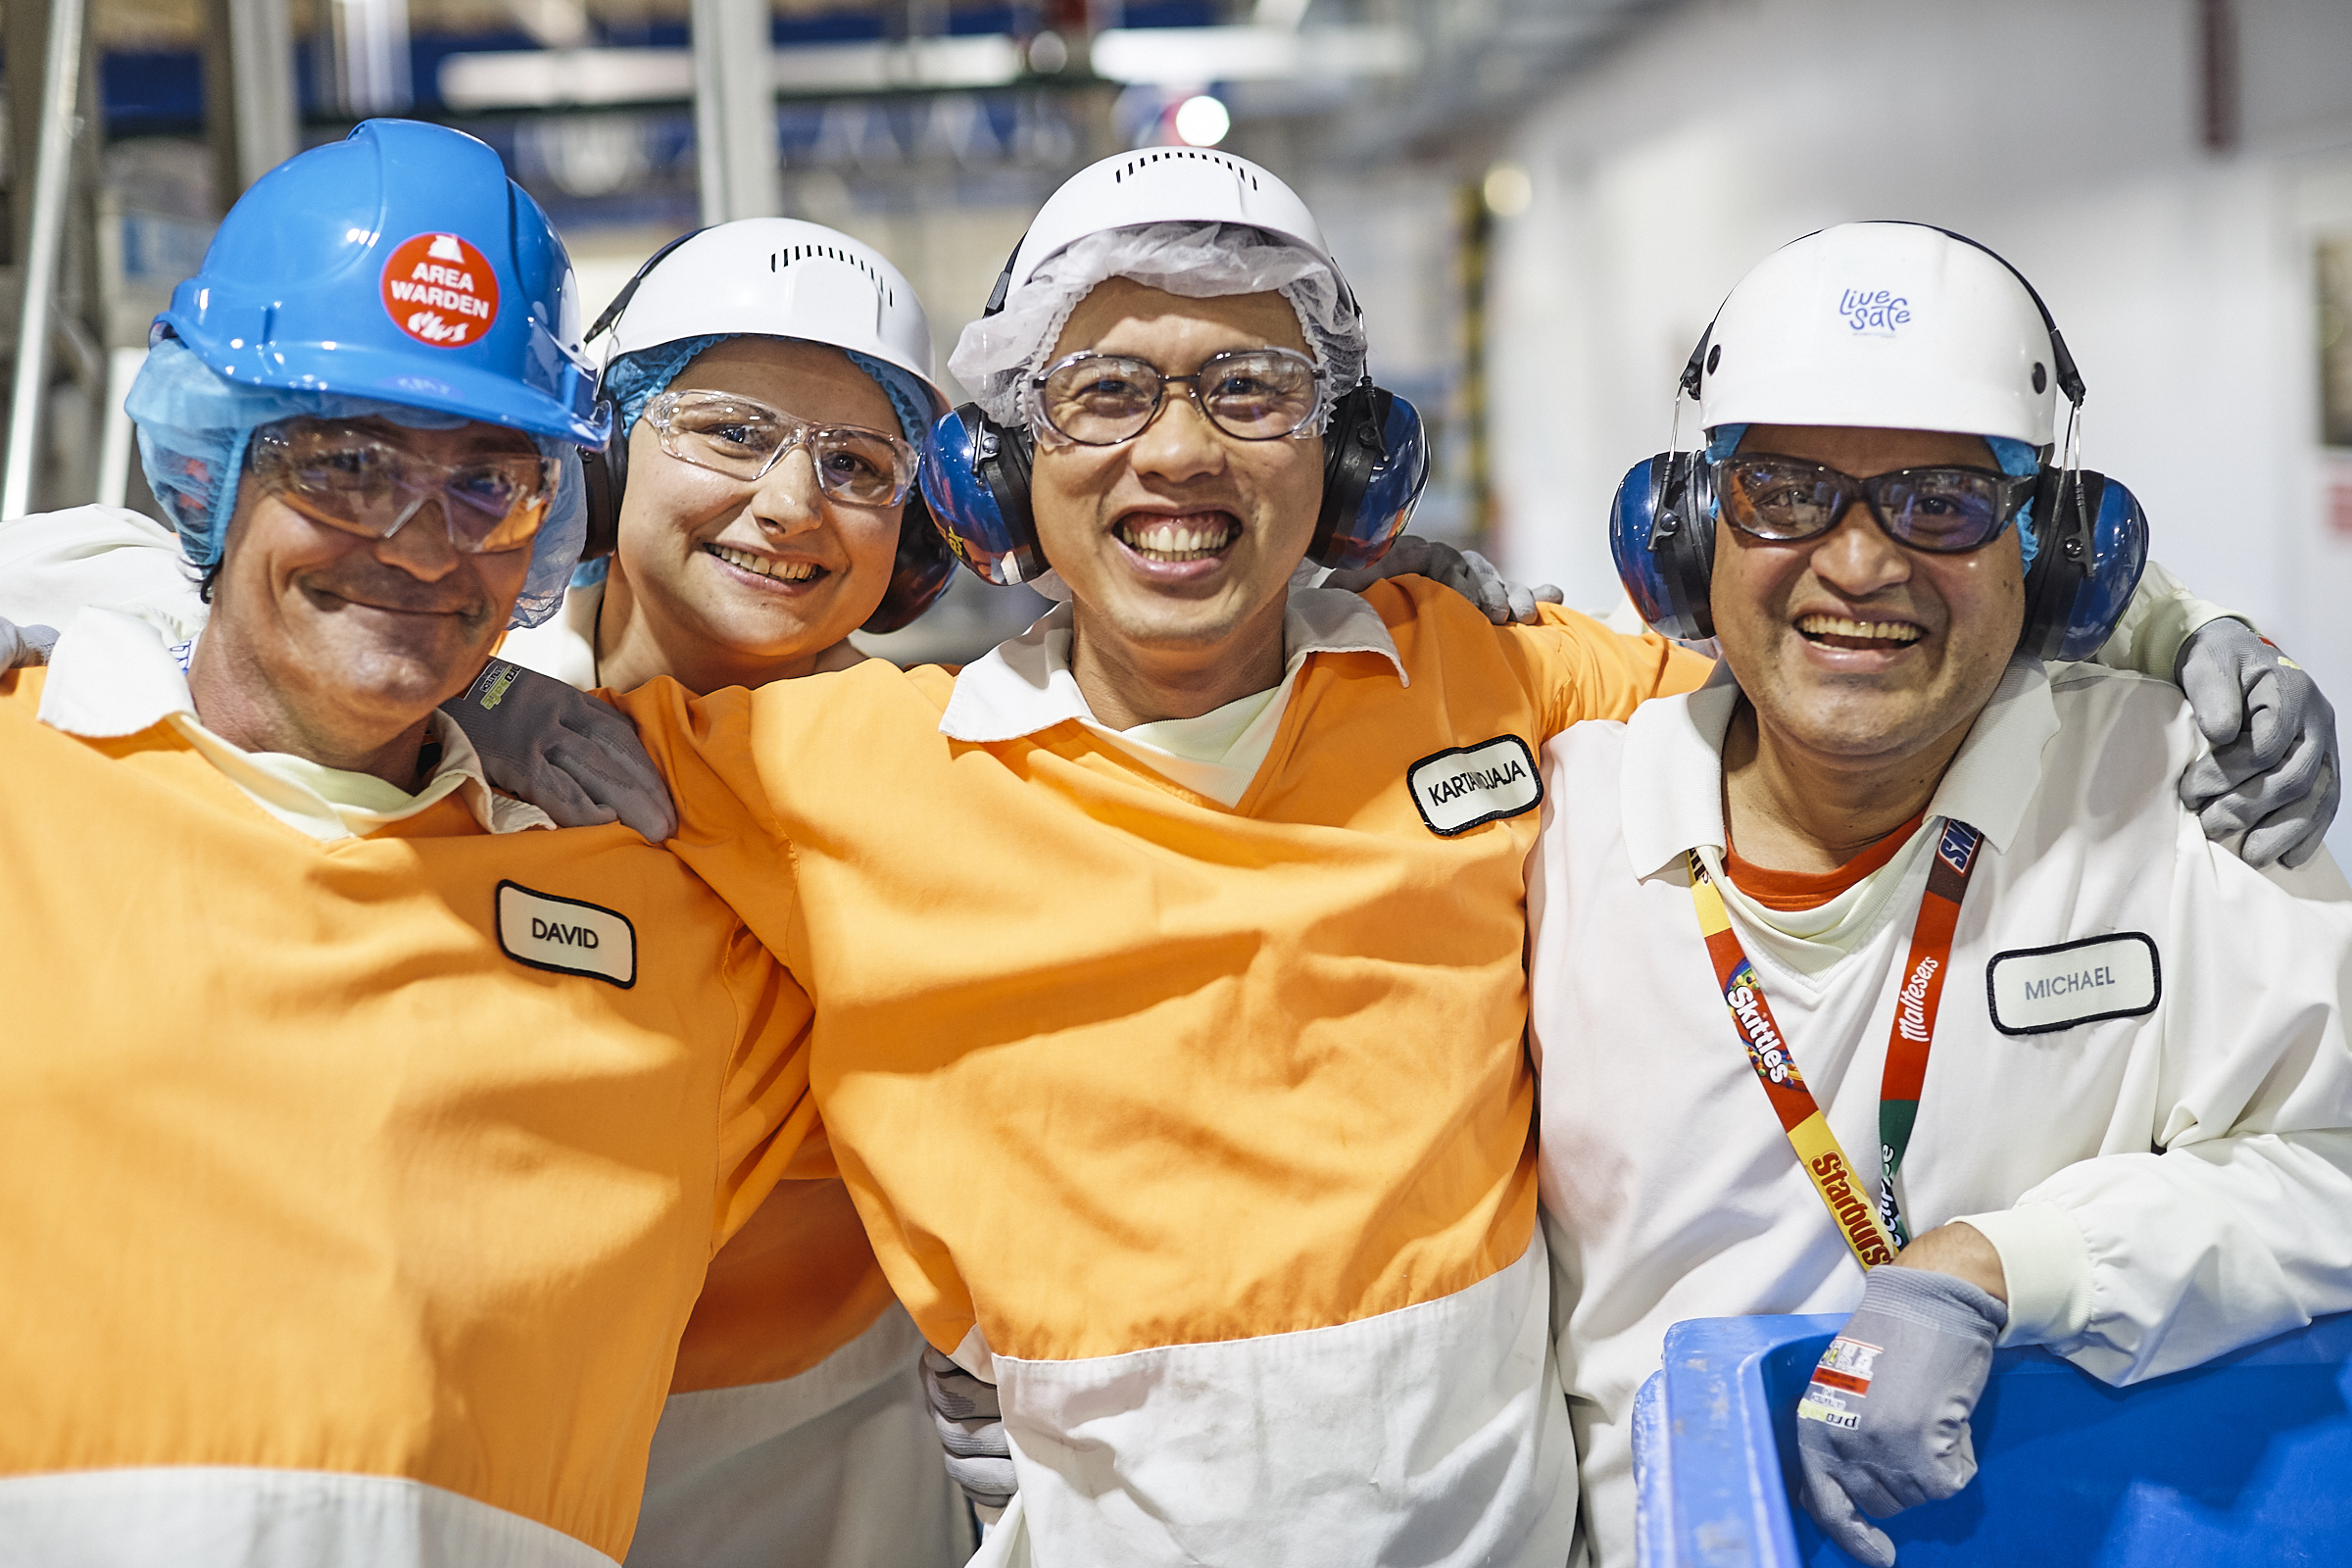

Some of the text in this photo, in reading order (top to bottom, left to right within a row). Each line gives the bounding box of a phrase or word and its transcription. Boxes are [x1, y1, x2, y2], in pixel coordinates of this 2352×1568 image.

[412, 262, 474, 293] AREA
[390, 279, 490, 319] WARDEN
[532, 917, 599, 949] DAVID
[1898, 956, 1939, 1043] Maltesers
[2025, 965, 2116, 1001] MICHAEL
[1727, 985, 1789, 1084] Skittles
[1811, 1152, 1893, 1266] Starburs
